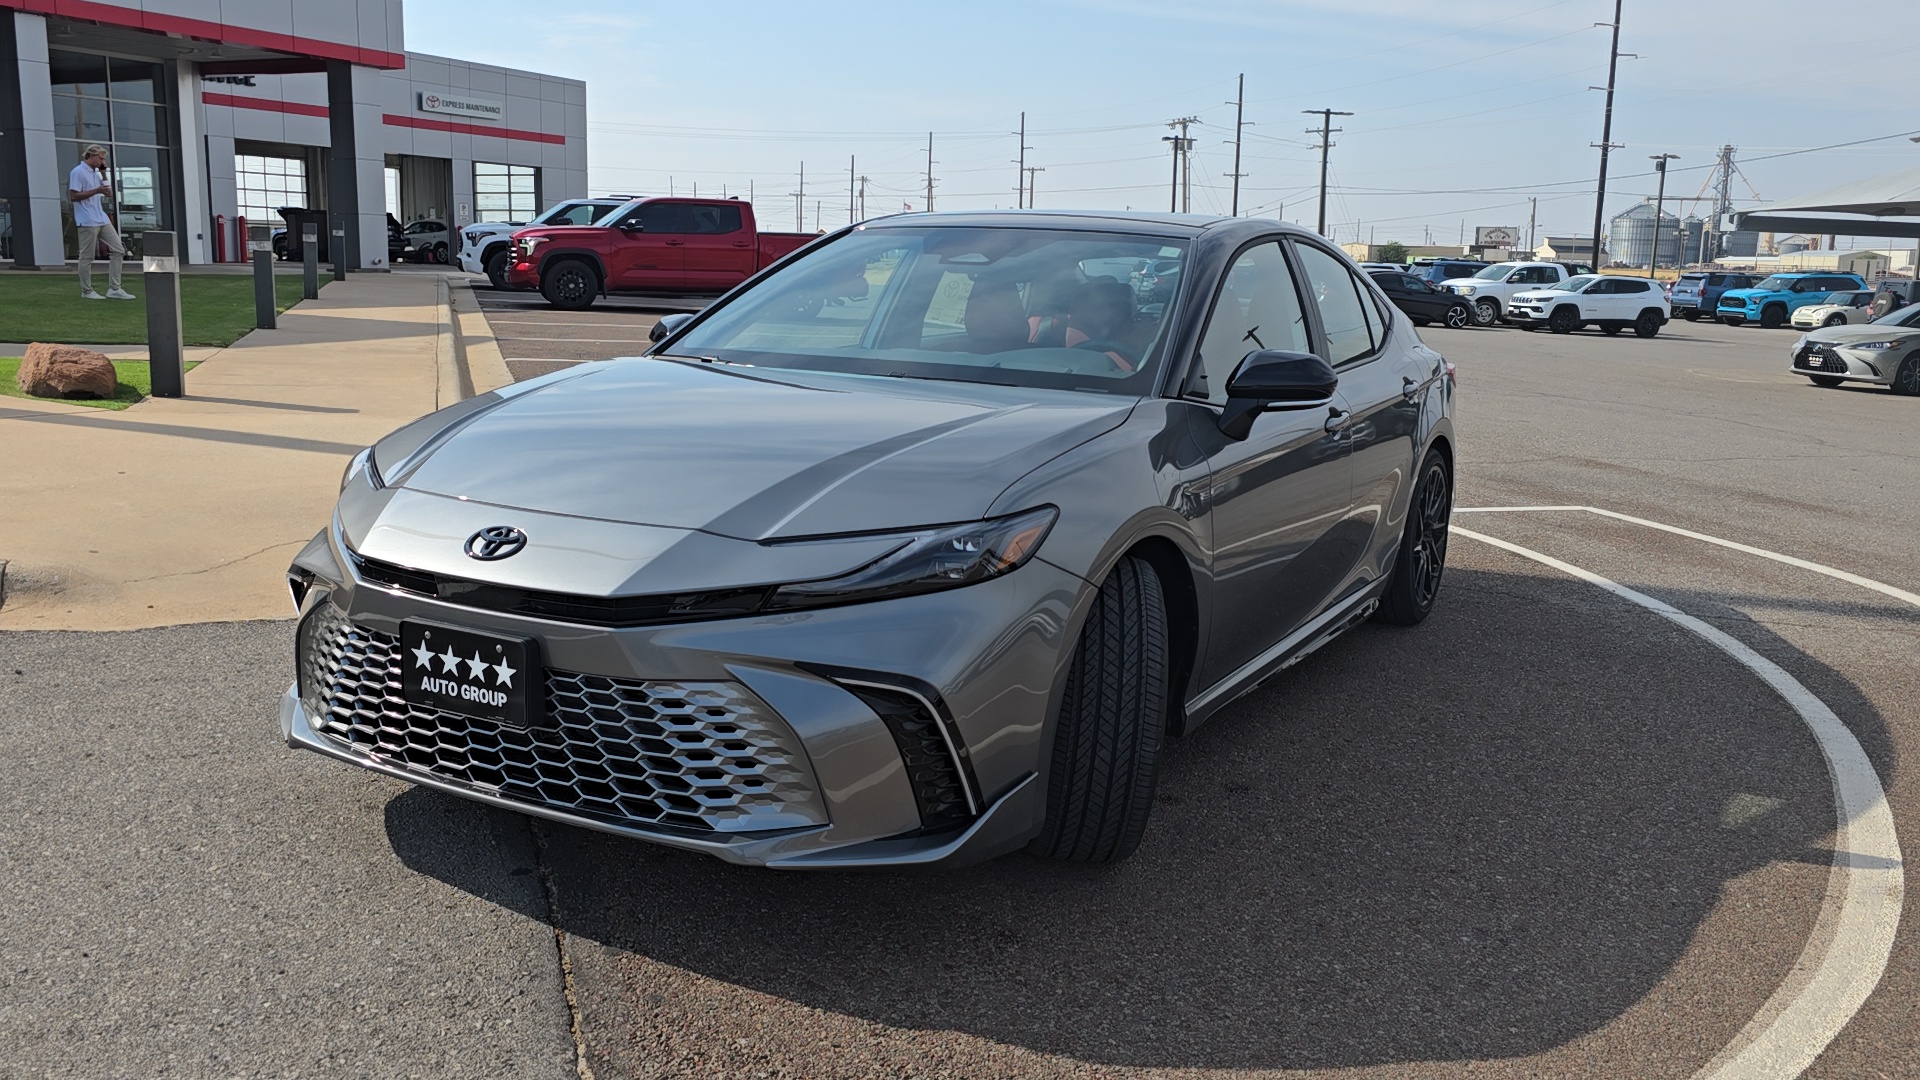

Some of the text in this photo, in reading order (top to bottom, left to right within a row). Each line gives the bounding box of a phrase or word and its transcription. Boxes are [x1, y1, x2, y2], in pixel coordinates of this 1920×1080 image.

[442, 100, 501, 115] EXPRESS MAINTENANCE
[421, 676, 508, 707] AUTO GROUP
